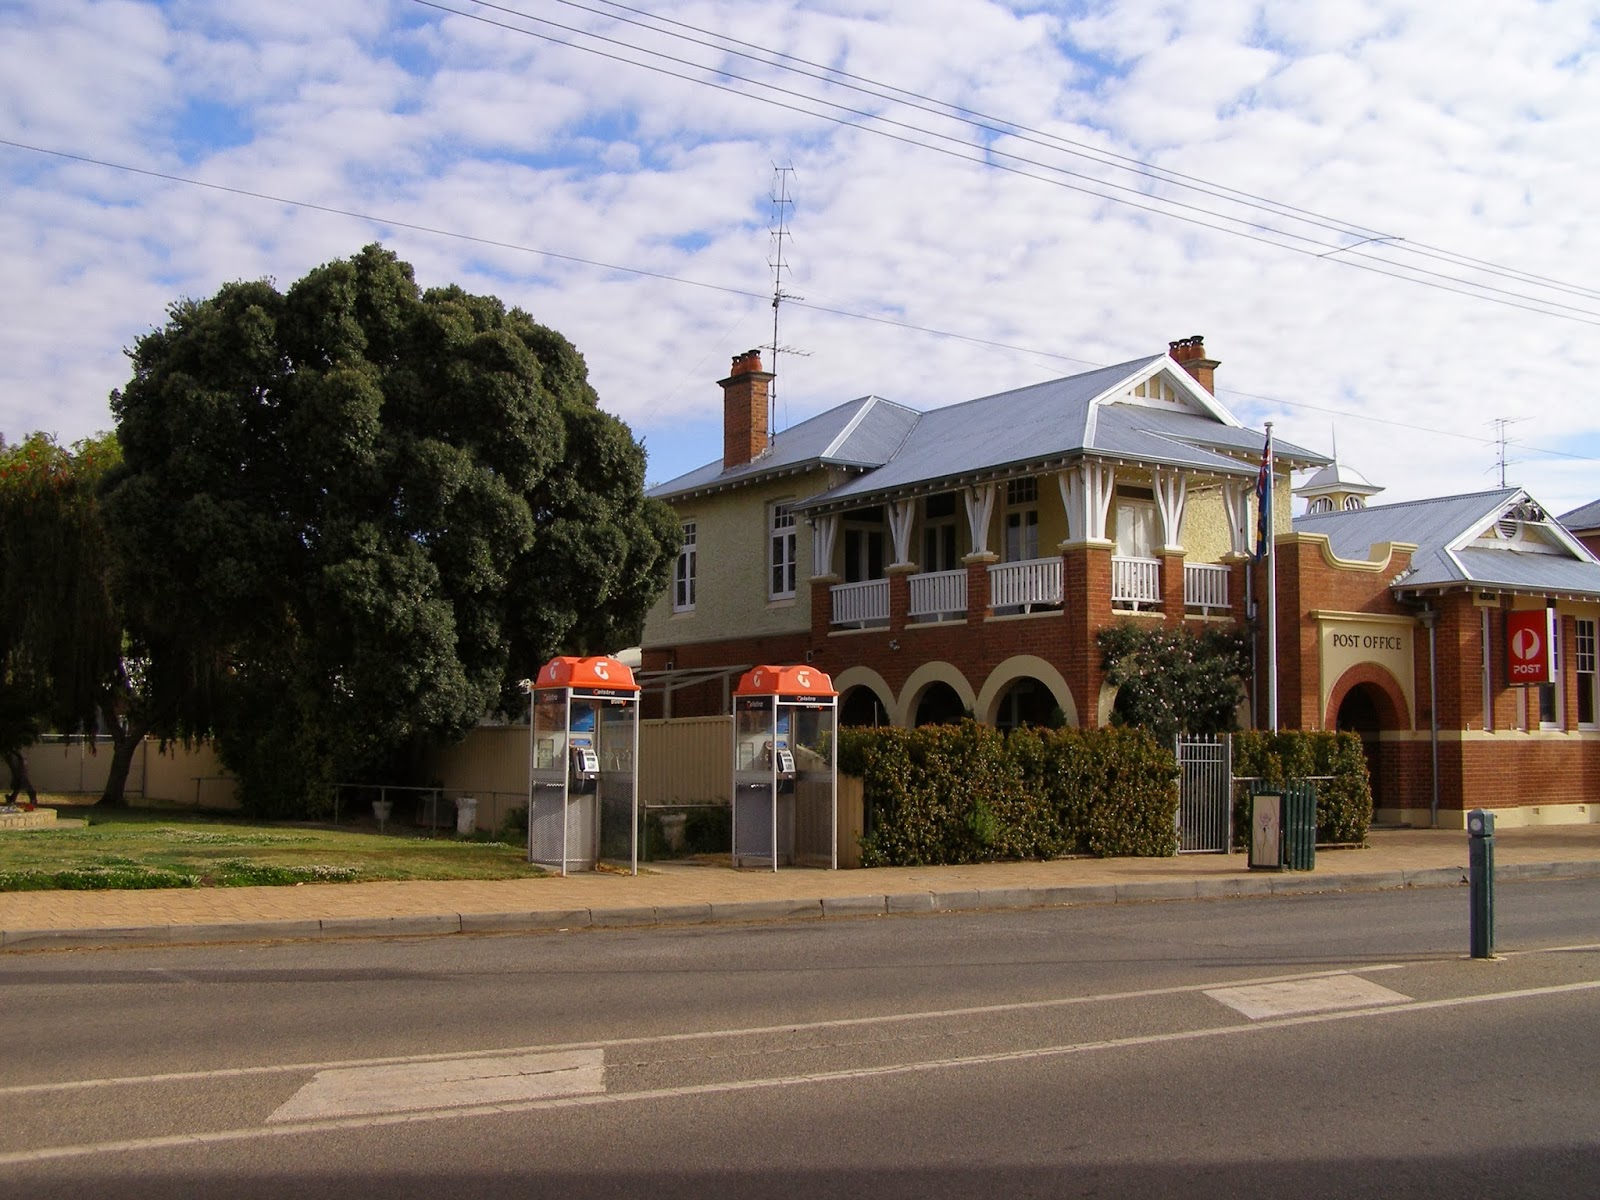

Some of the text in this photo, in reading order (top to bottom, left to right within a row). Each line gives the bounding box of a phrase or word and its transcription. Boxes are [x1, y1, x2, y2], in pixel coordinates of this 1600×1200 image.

[1333, 634, 1402, 650] POST OFFICE
[1513, 664, 1540, 674] POST
